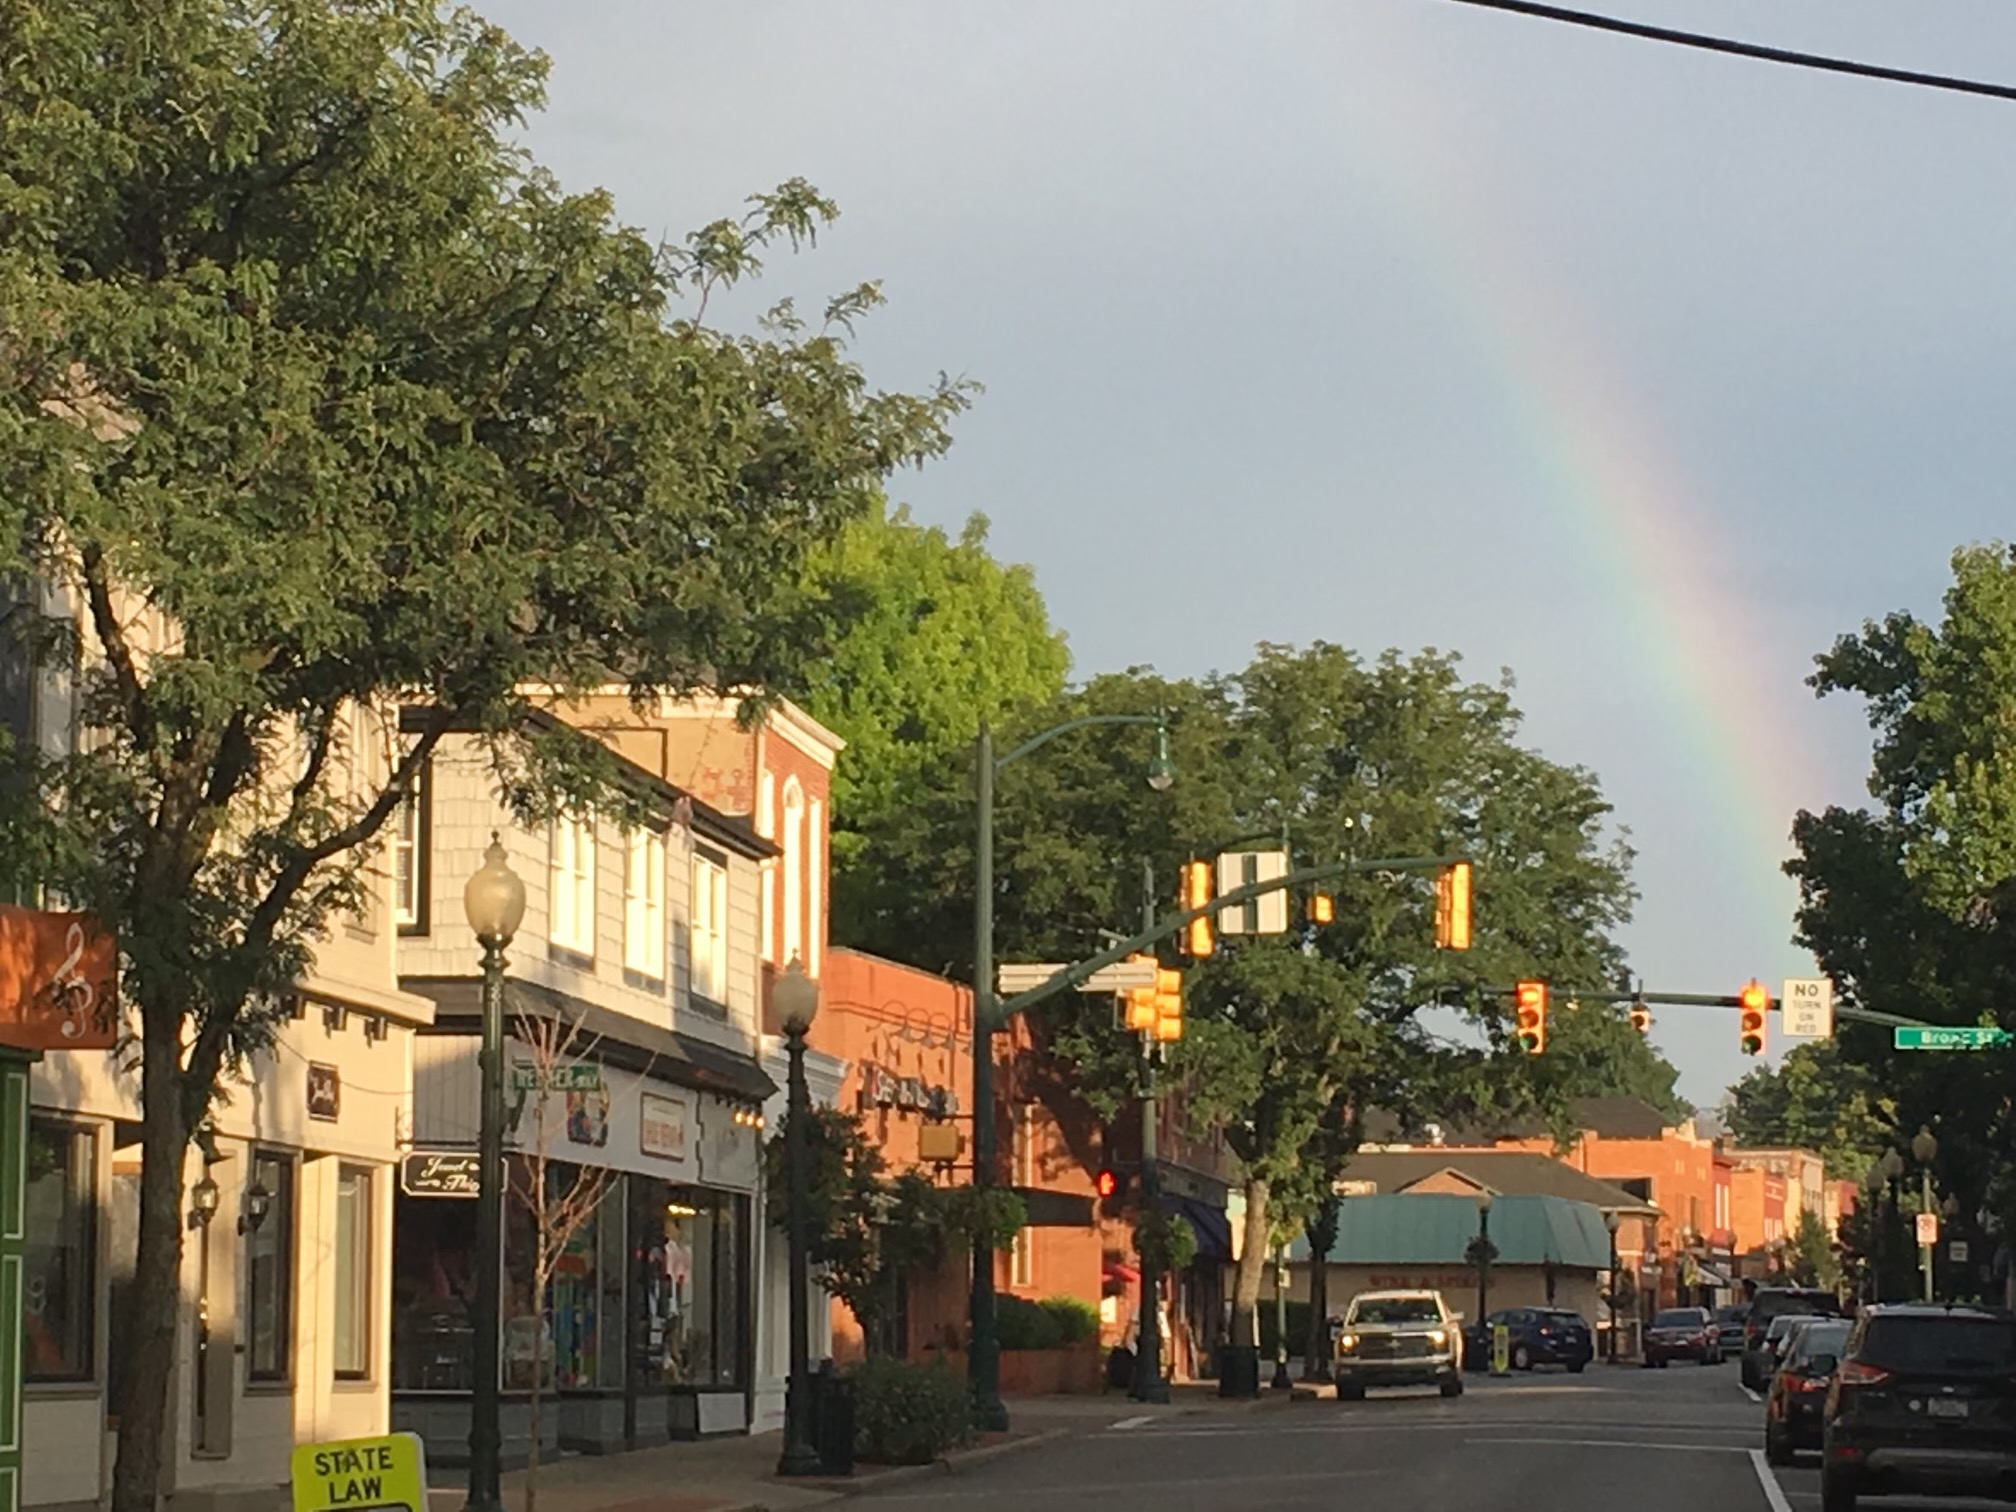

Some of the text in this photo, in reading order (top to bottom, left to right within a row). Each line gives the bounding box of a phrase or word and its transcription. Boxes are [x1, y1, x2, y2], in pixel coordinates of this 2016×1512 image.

[1795, 984, 1818, 997] NO
[315, 1446, 394, 1476] STATE
[329, 1476, 381, 1504] LAW
